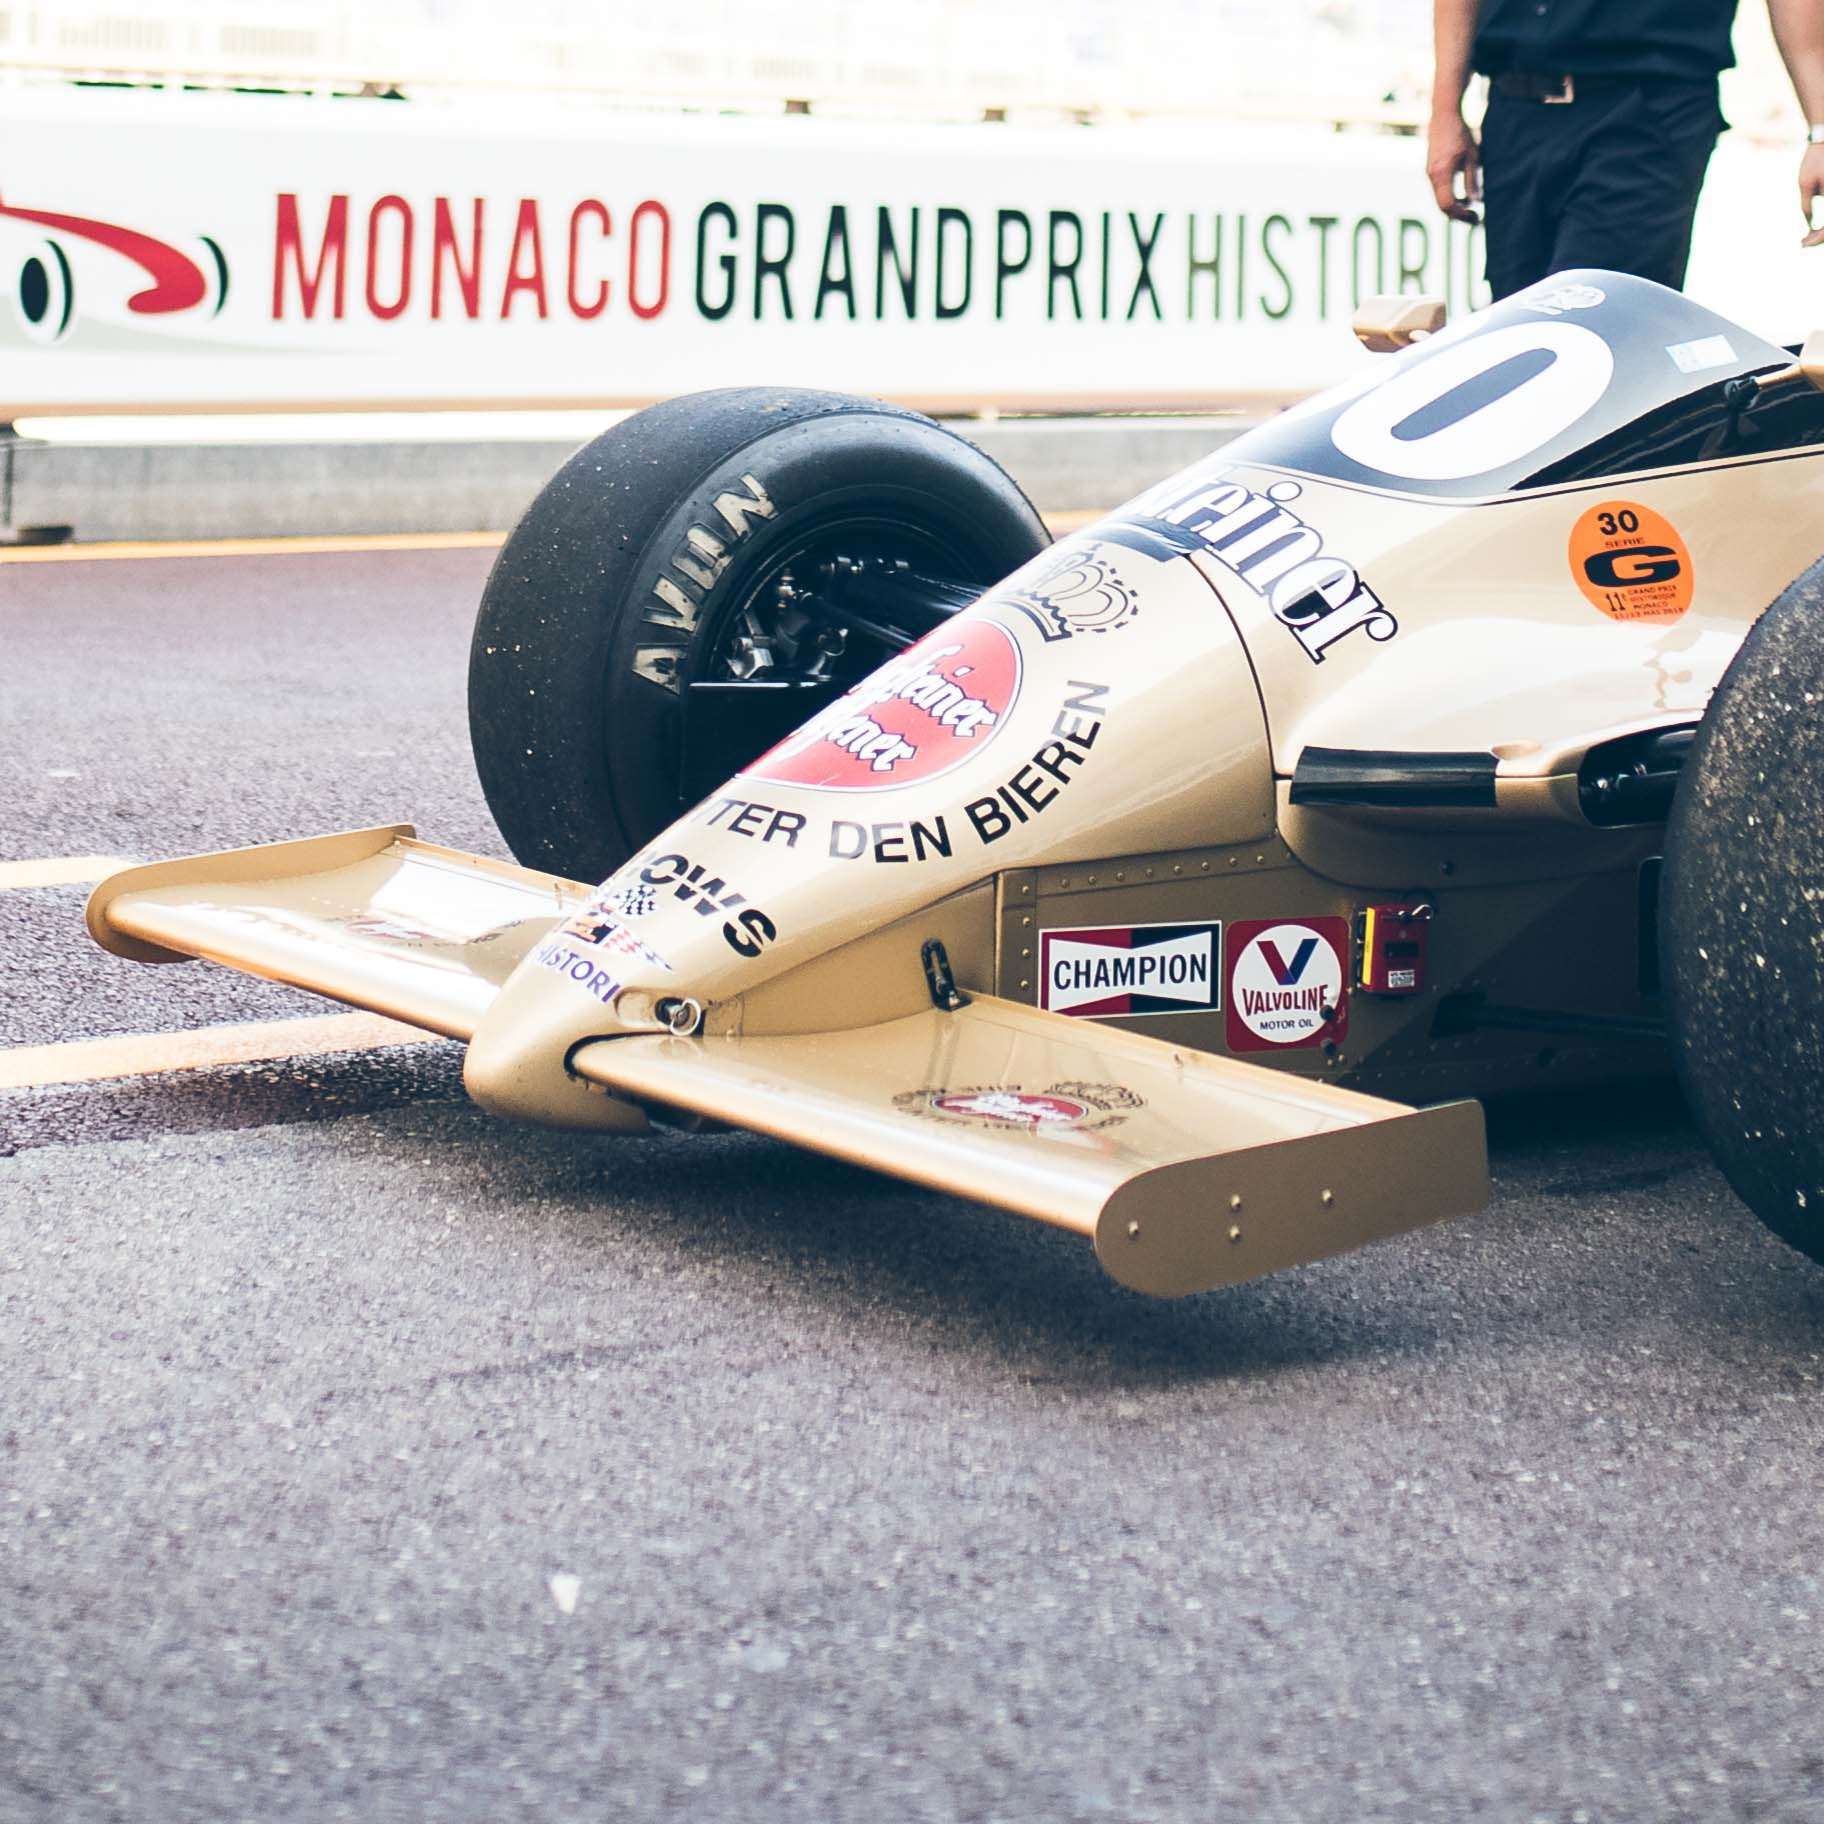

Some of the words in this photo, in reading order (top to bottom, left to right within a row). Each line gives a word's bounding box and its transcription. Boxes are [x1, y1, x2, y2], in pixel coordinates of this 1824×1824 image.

[272, 192, 670, 320] MONACO
[1598, 509, 1639, 536] 30
[1605, 536, 1646, 548] SERIE
[632, 472, 778, 695] AVON
[1584, 545, 1681, 588] G
[698, 798, 807, 849] TER
[829, 815, 953, 864] DEN
[964, 679, 1111, 845] BIEREN
[636, 853, 777, 958] OWS
[1053, 952, 1207, 991] CHAMPION
[1242, 983, 1329, 1017] VALVOLINE
[1260, 1019, 1296, 1031] MOTOR
[1298, 1018, 1314, 1028] OIL
